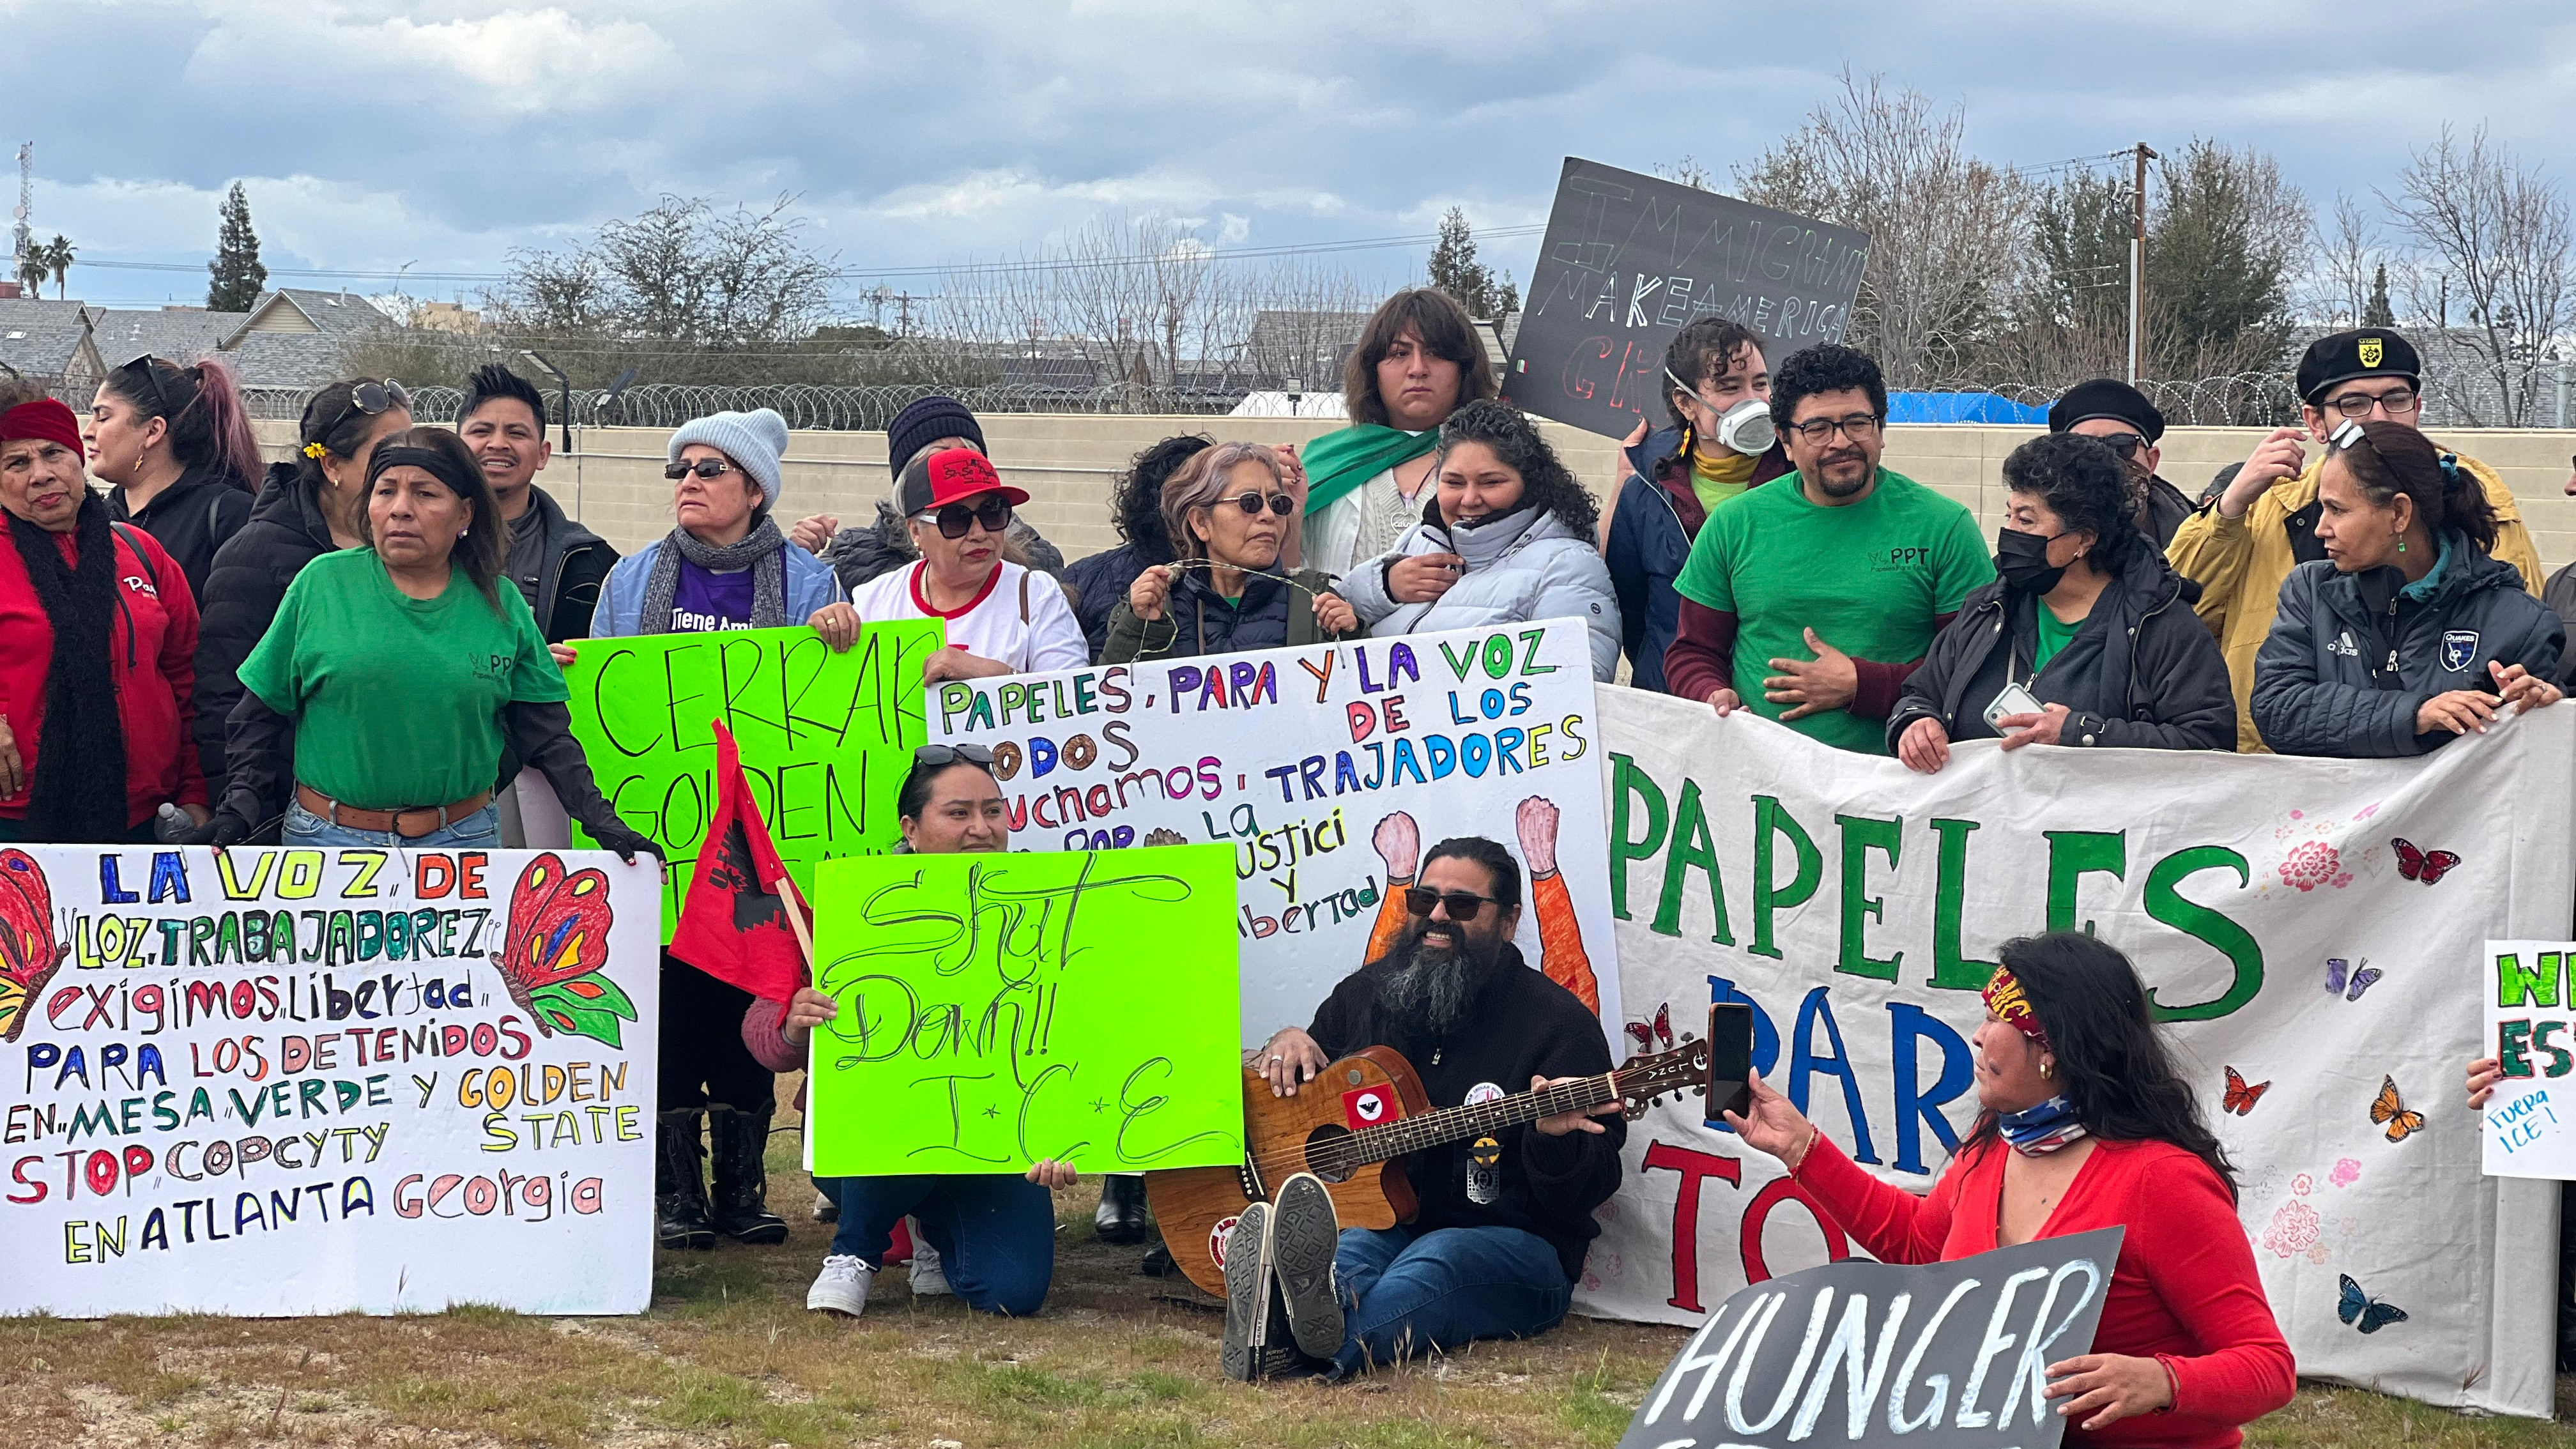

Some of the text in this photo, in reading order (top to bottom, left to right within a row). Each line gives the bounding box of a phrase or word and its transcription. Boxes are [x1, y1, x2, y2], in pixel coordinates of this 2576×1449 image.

[1537, 270, 1694, 328] MAKE
[1890, 548, 1929, 564] PPT
[671, 608, 753, 632] Tiene Ami
[2445, 634, 2475, 642] QUAKES
[595, 630, 939, 757] CERRAR
[1167, 661, 1278, 714] PARA
[1298, 649, 1334, 704] Y
[1355, 641, 1420, 694] LA
[1439, 628, 1558, 684] VOZ
[1346, 682, 1533, 744] DE LOS
[992, 721, 1139, 782] ODOS
[1265, 714, 1588, 804] TRAJADORES
[1003, 756, 1222, 832] uchamos
[100, 852, 191, 904] LA
[415, 851, 489, 900] DE
[1270, 868, 1296, 904] Y
[1608, 750, 2266, 1023] PAPELES
[158, 908, 493, 967] TRABAJADOREZ
[820, 852, 1192, 992] Shut
[26, 1043, 168, 1094] PARA
[190, 1034, 270, 1082] LOS
[1648, 1062, 1689, 1080] LUNA
[1702, 974, 1975, 1176] PAR
[2497, 1017, 2576, 1080] ES
[66, 1086, 215, 1144] MESA
[229, 1074, 393, 1127] VERDE
[411, 1071, 438, 1109] Y
[459, 1061, 628, 1112] GOLDEN
[480, 1105, 643, 1151] STATE
[165, 1122, 390, 1181] COPCYTY
[64, 1168, 604, 1264] EN ATLANTA Georgia
[1643, 1259, 2102, 1443] HUNGER
